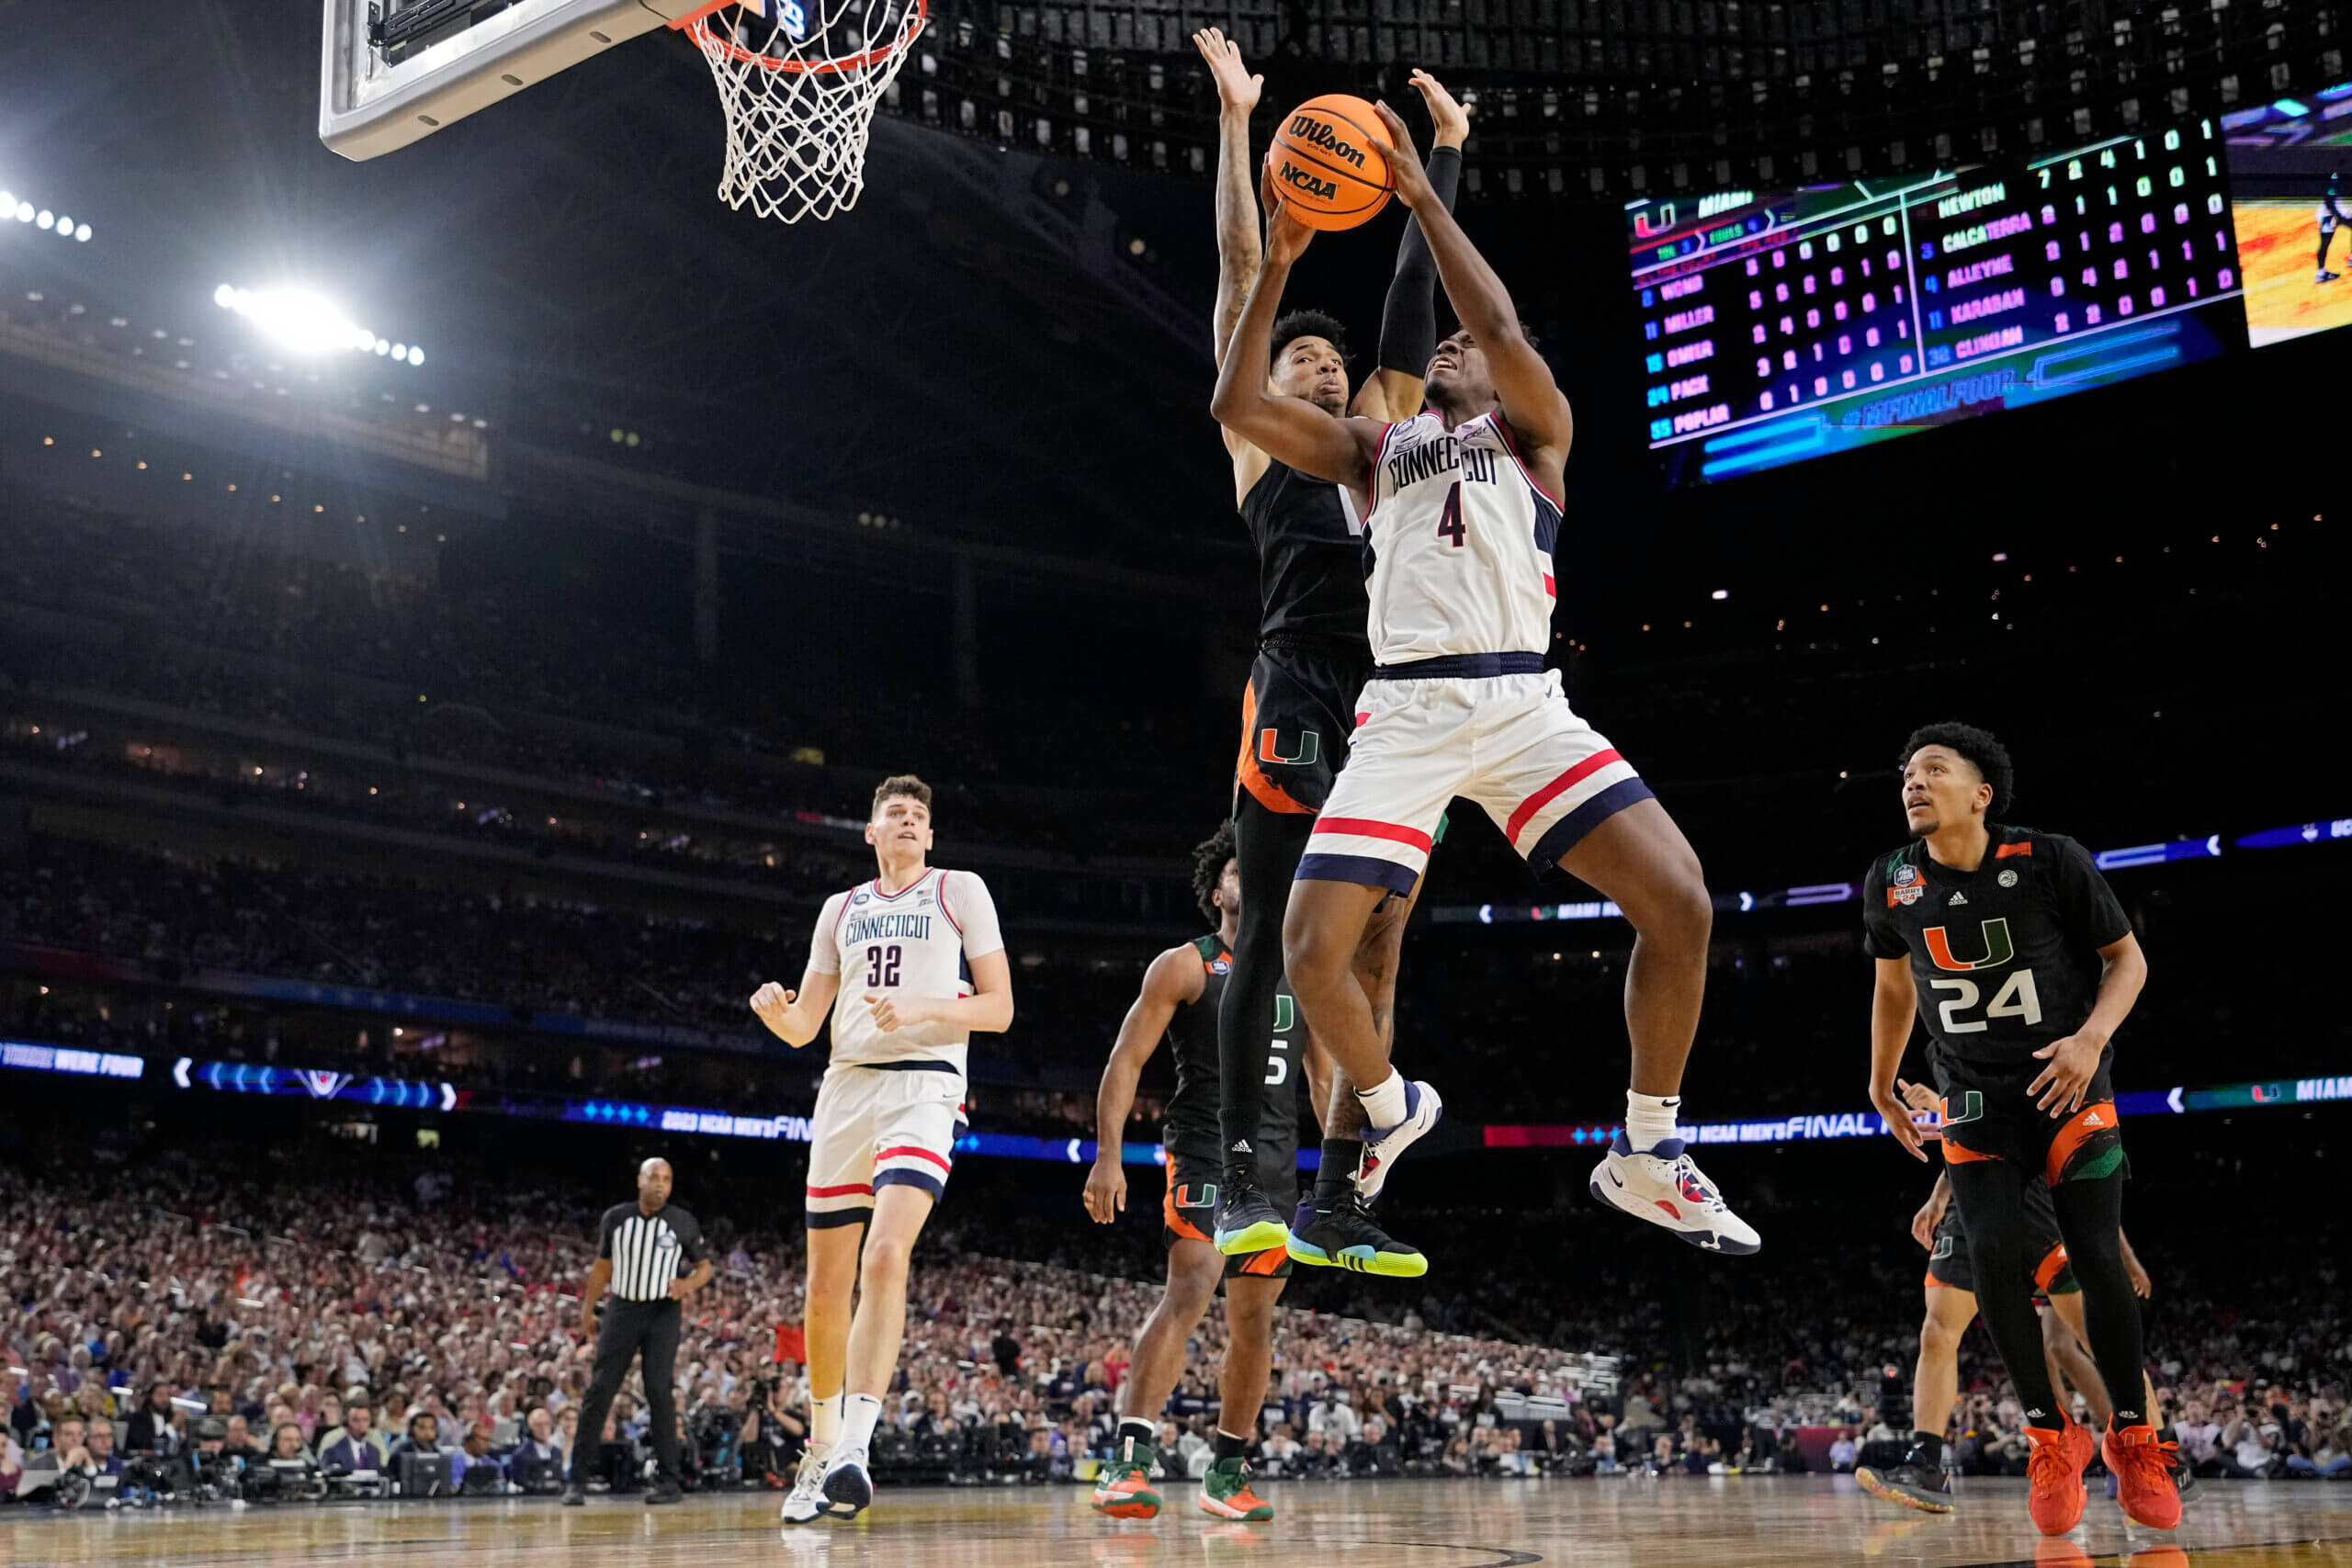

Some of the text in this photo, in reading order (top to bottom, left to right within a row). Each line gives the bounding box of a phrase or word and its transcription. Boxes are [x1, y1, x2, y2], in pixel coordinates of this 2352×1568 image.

[1289, 116, 1365, 170] Wilson
[1279, 161, 1338, 200] NCAA
[1938, 182, 2006, 219] NEWTON
[2038, 167, 2051, 189] 7
[2135, 140, 2145, 160] 1
[2165, 129, 2180, 151] 0
[2201, 118, 2212, 140] 1
[1698, 191, 1753, 219] MIAMI
[1942, 211, 2033, 254] CALCATERRA
[2076, 195, 2086, 215] 1
[2107, 186, 2118, 206] 1
[2137, 175, 2152, 197] 0
[2169, 166, 2185, 187] 0
[2206, 156, 2217, 176] 1
[1948, 254, 2015, 289] ALLEYNE
[2079, 231, 2090, 251] 1
[2141, 212, 2155, 234] 0
[2174, 202, 2189, 224] 0
[2207, 193, 2223, 215] 0
[2148, 249, 2160, 270] 1
[2181, 240, 2193, 261] 1
[2215, 230, 2227, 251] 1
[1664, 305, 1714, 334] MILLER
[1860, 257, 1871, 277] 1
[1893, 284, 1904, 305] 1
[2118, 294, 2133, 316] 0
[2150, 286, 2166, 308] 0
[2187, 276, 2198, 298] 1
[1670, 375, 1710, 401] PACK
[1813, 342, 1824, 362] 1
[1897, 319, 1908, 339] 1
[1649, 418, 1673, 440] 55
[1673, 404, 1730, 434] POPLAR
[1790, 383, 1800, 403] 1
[1387, 436, 1498, 497] CONNECCUT
[1437, 480, 1466, 547] 4
[1260, 728, 1319, 765] U
[845, 914, 932, 948] CONNECTICUT
[1922, 917, 2014, 971] U
[866, 945, 902, 987] 32
[1929, 967, 2043, 1034] 24
[2296, 1077, 2352, 1100] MIAM
[773, 1115, 814, 1142] FIN
[1785, 1112, 1874, 1140] FINAL
[1175, 1183, 1217, 1208] U
